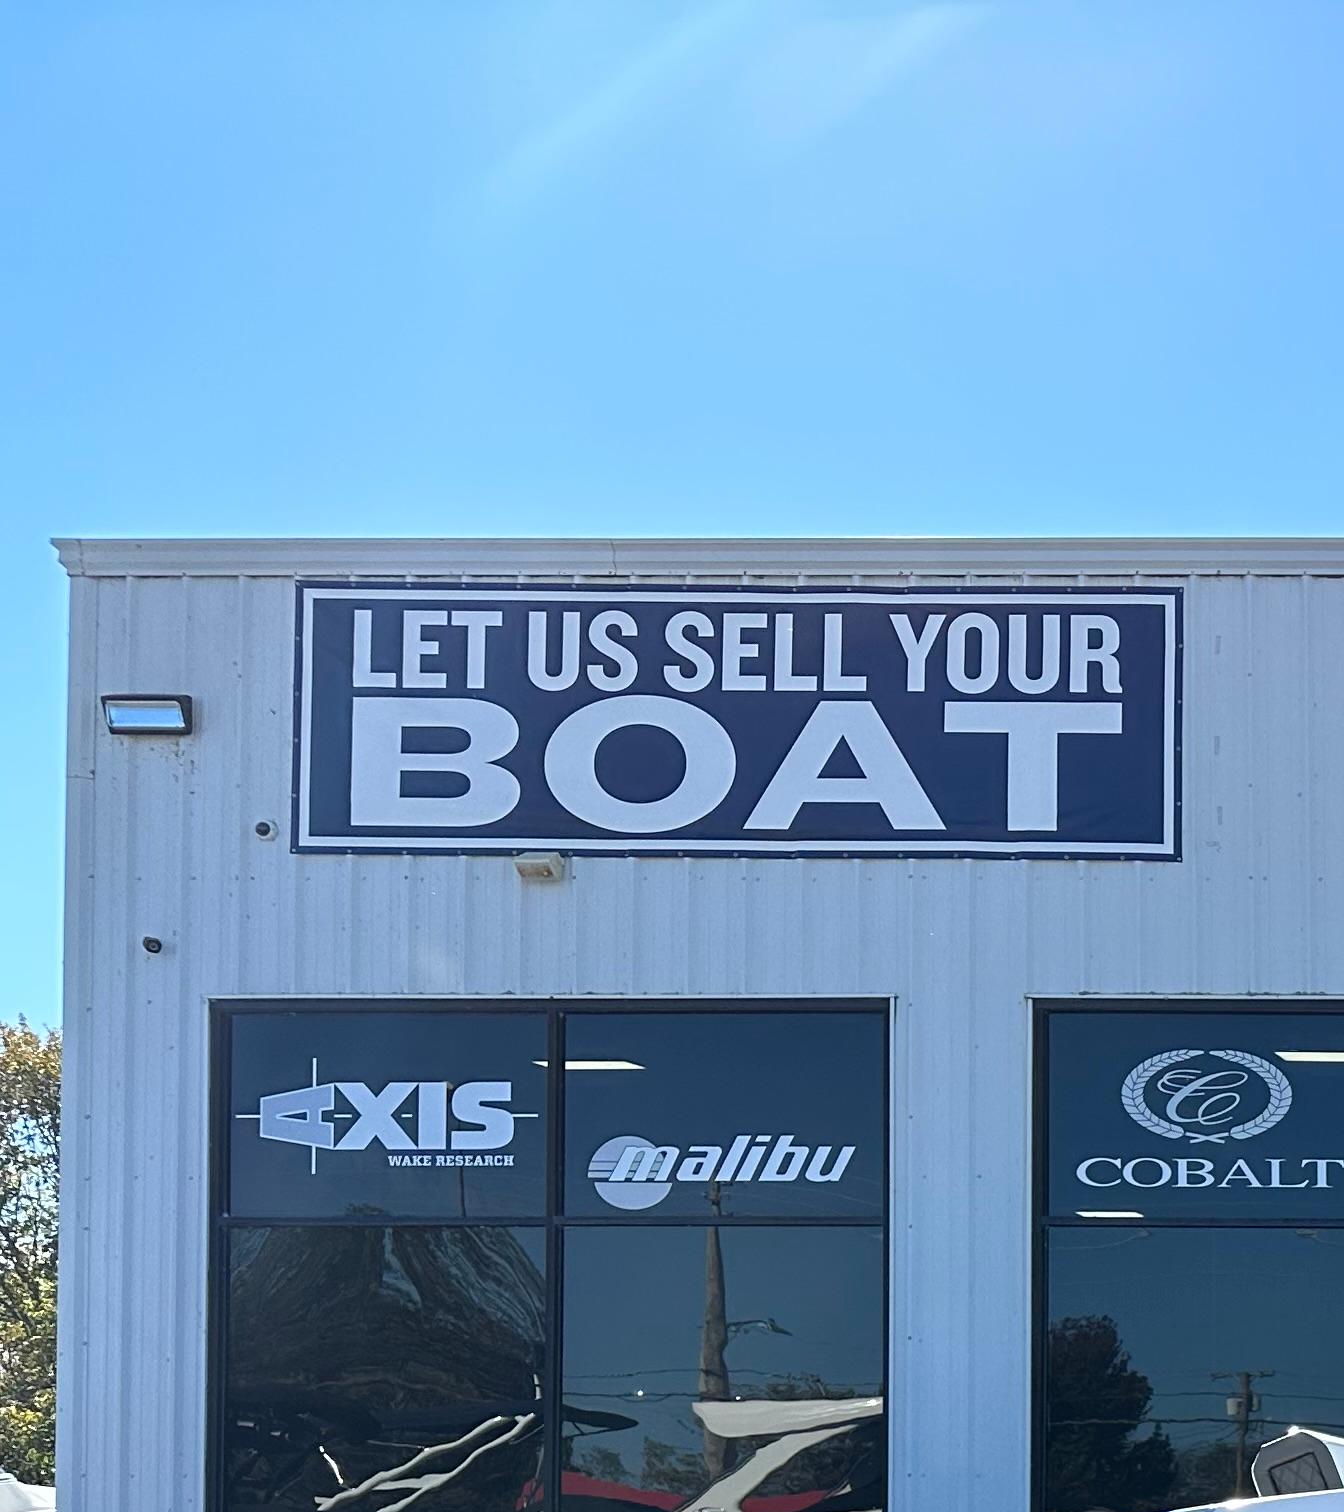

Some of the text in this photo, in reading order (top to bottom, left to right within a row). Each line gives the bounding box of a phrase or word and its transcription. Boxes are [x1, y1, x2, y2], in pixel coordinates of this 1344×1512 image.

[353, 609, 1123, 695] LET US SELL YOUR
[350, 694, 1123, 833] BOAT
[260, 1082, 515, 1150] AXIS
[388, 1154, 514, 1168] WAKE RESEARCH
[610, 1135, 856, 1182] malibu
[1076, 1157, 1344, 1188] COBALT
